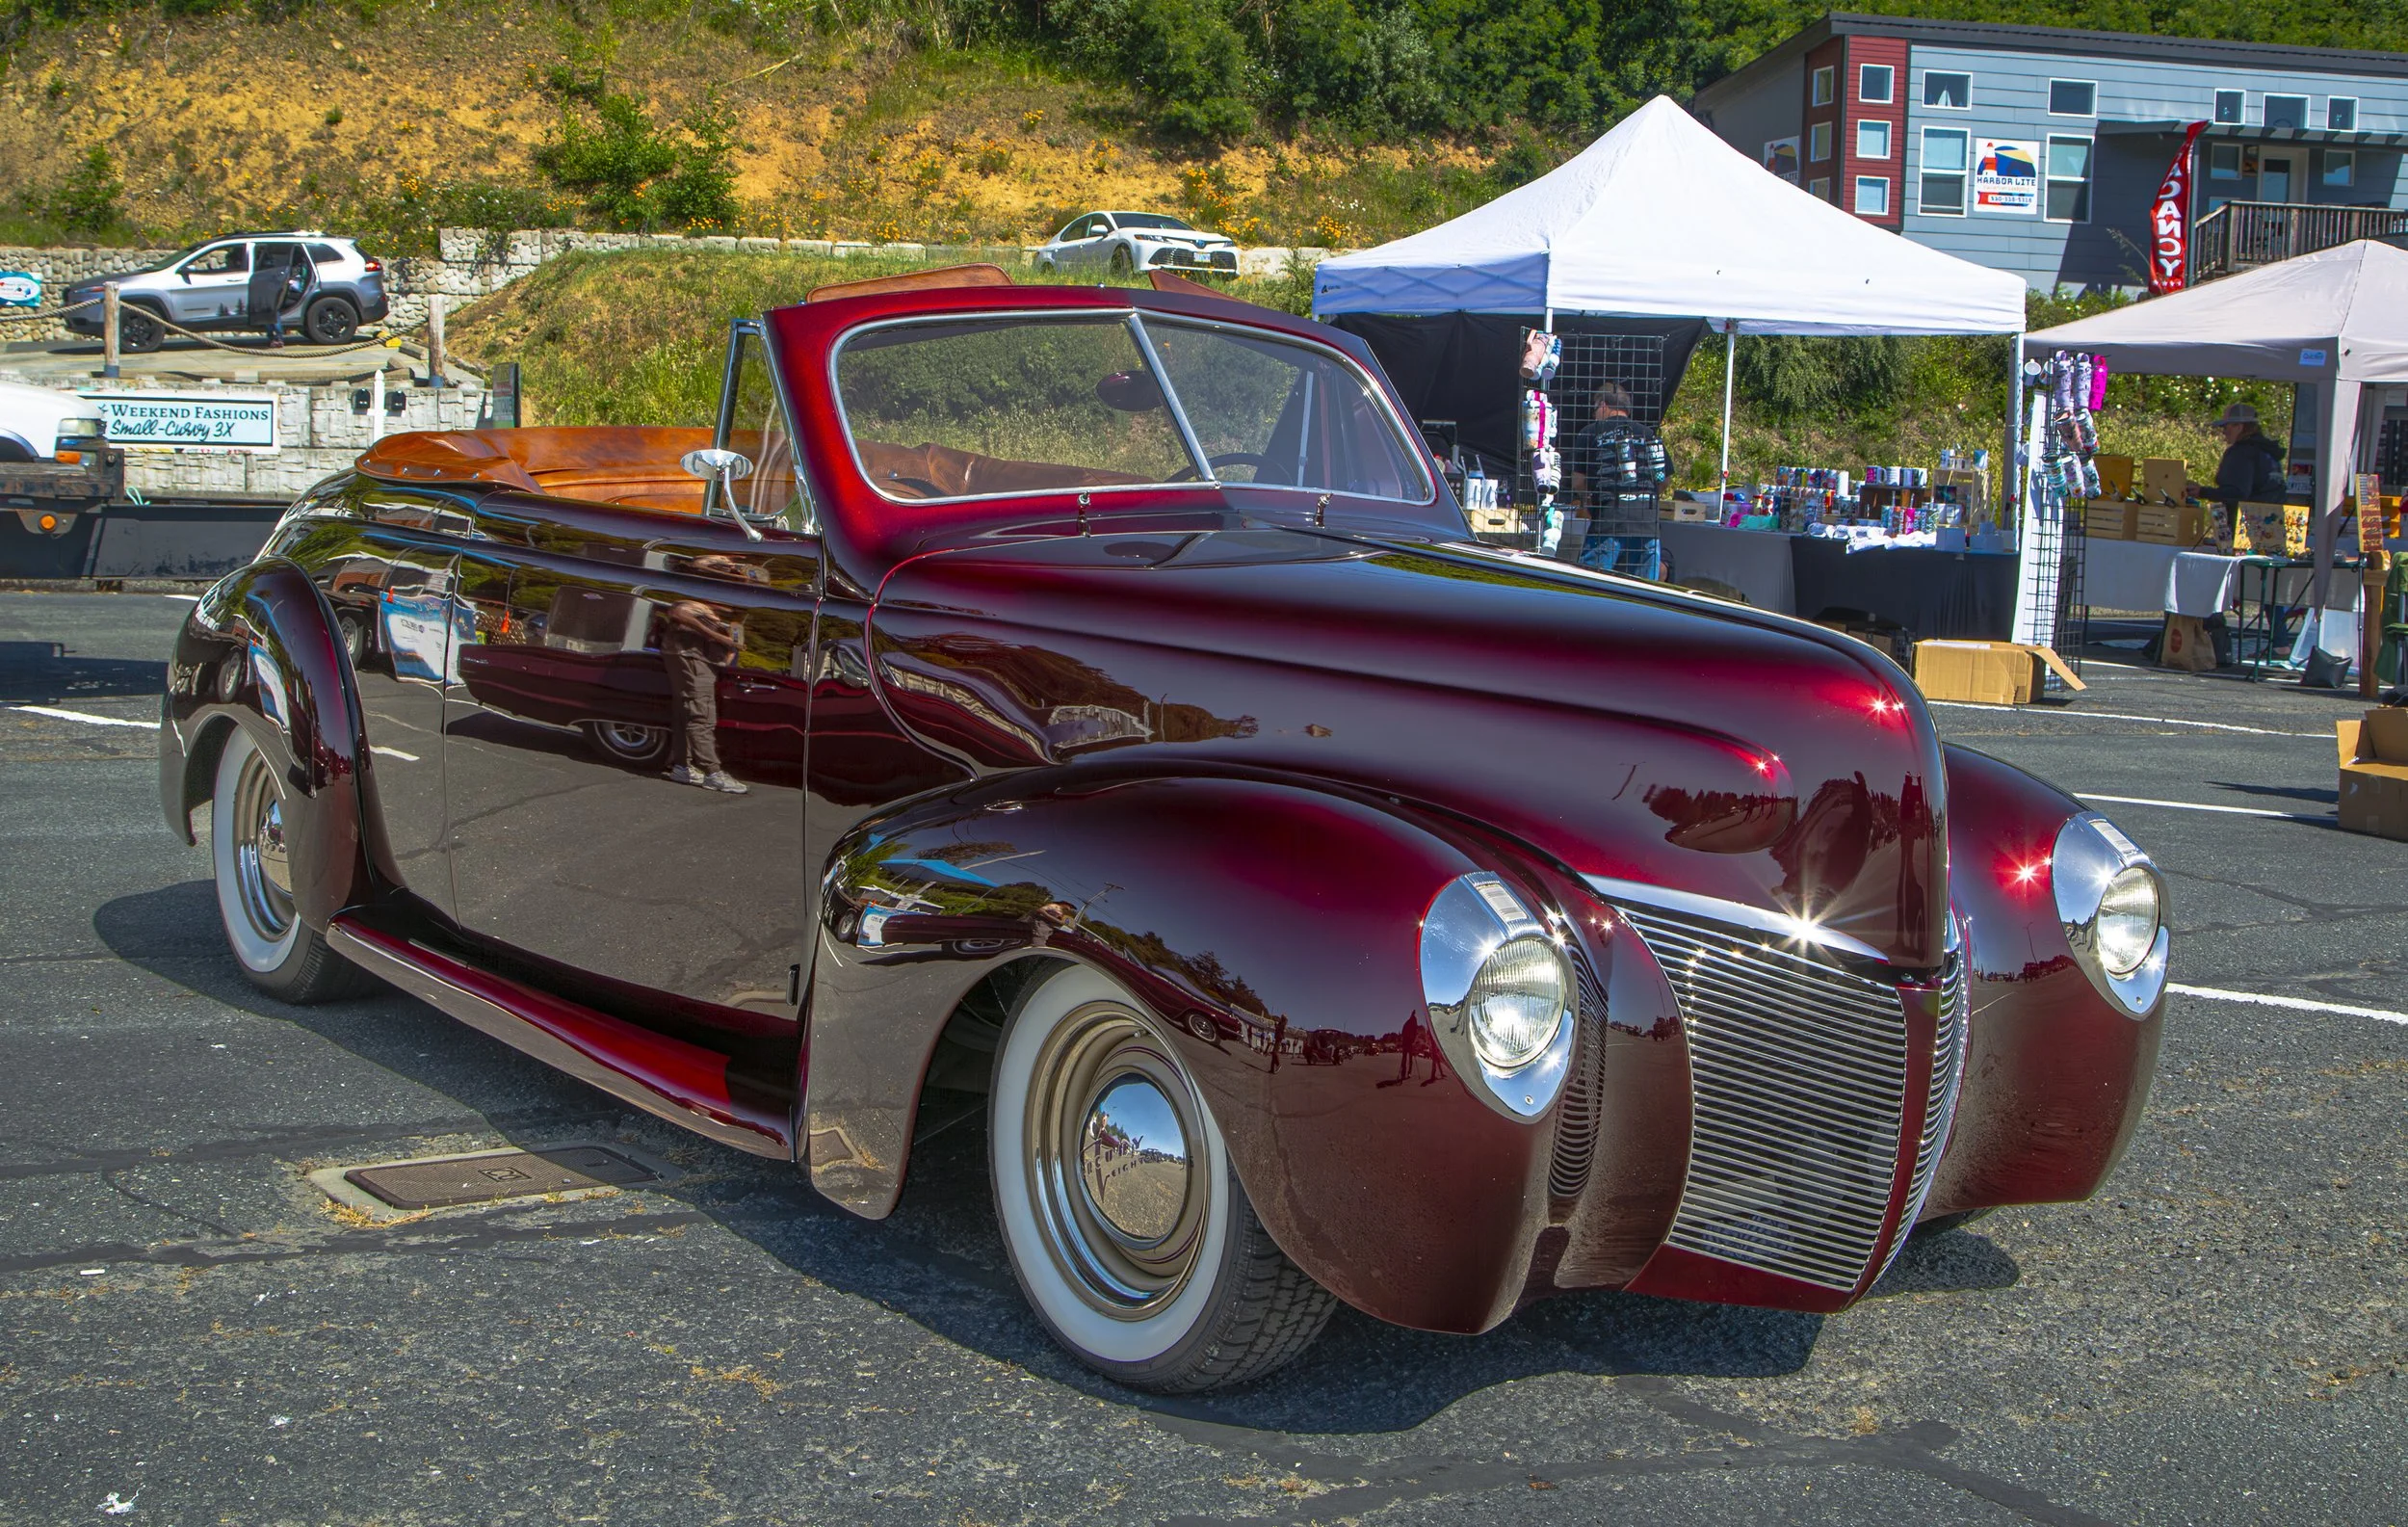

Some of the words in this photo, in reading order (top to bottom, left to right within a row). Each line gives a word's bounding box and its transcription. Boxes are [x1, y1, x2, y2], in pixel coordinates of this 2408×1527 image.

[1976, 176, 2013, 185] HARBOR
[111, 404, 190, 418] WEEKEND
[195, 407, 269, 421] FASHIONS
[111, 419, 210, 442] Small-Curvy
[213, 421, 235, 437] 3X
